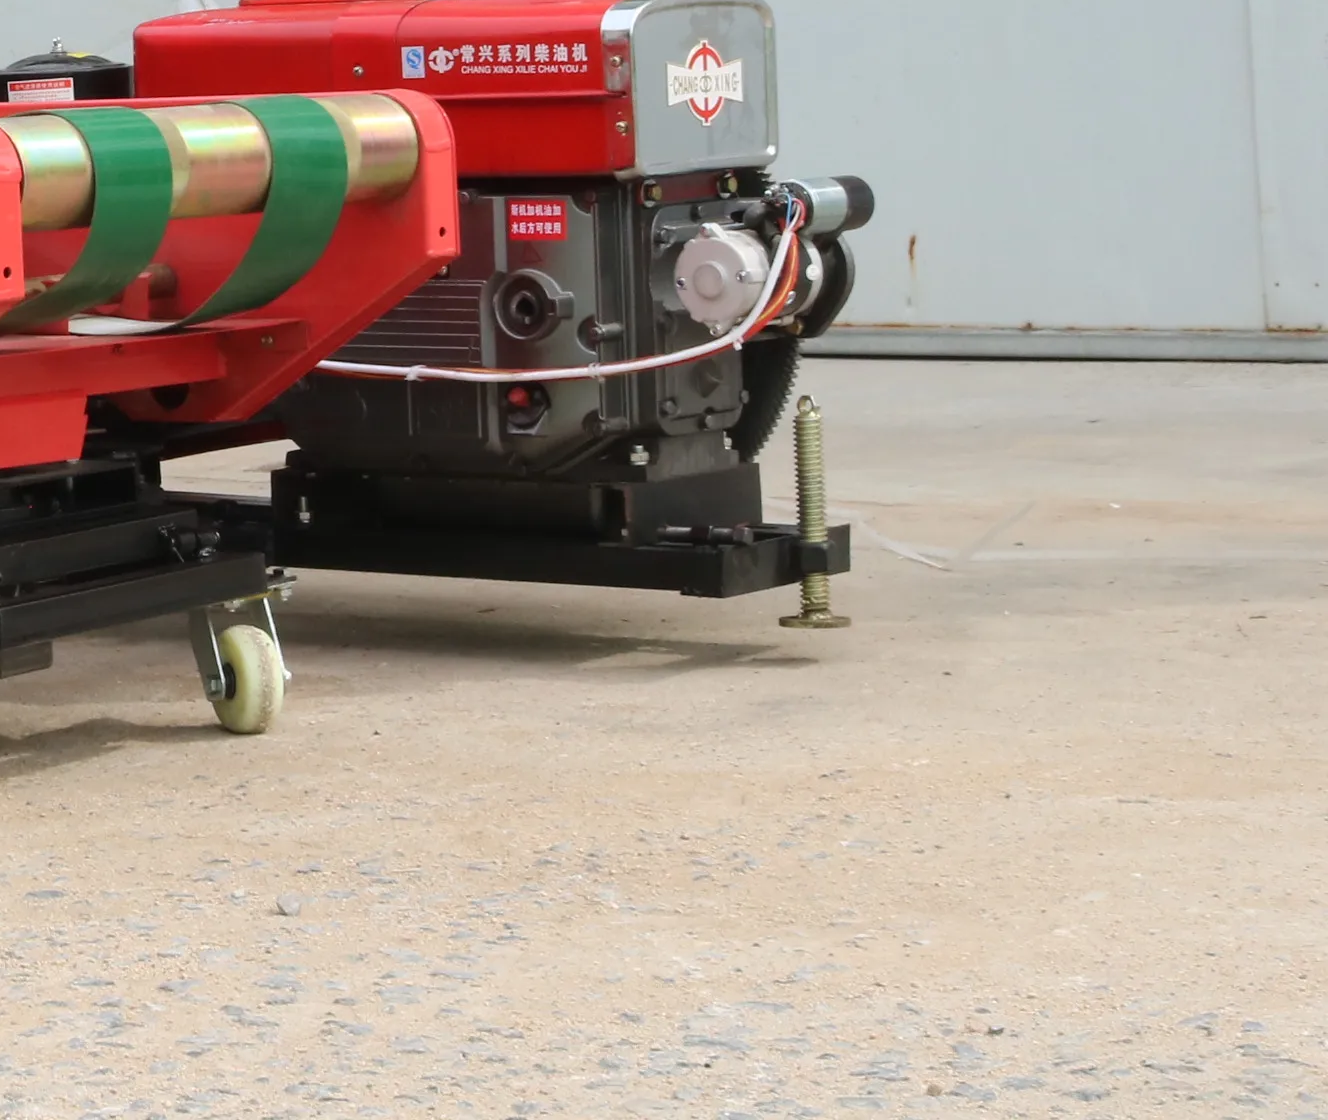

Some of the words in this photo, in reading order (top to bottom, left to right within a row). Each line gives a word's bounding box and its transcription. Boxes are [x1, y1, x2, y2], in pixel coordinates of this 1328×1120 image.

[459, 43, 588, 63] 常兴系列柴油机
[461, 65, 491, 74] CHANG
[493, 65, 514, 74] XING
[515, 65, 536, 74] XILIE
[538, 65, 558, 73] CHAI
[560, 65, 579, 73] YOU
[580, 65, 588, 73] JI
[673, 75, 698, 96] CHANG
[714, 72, 739, 92] XING
